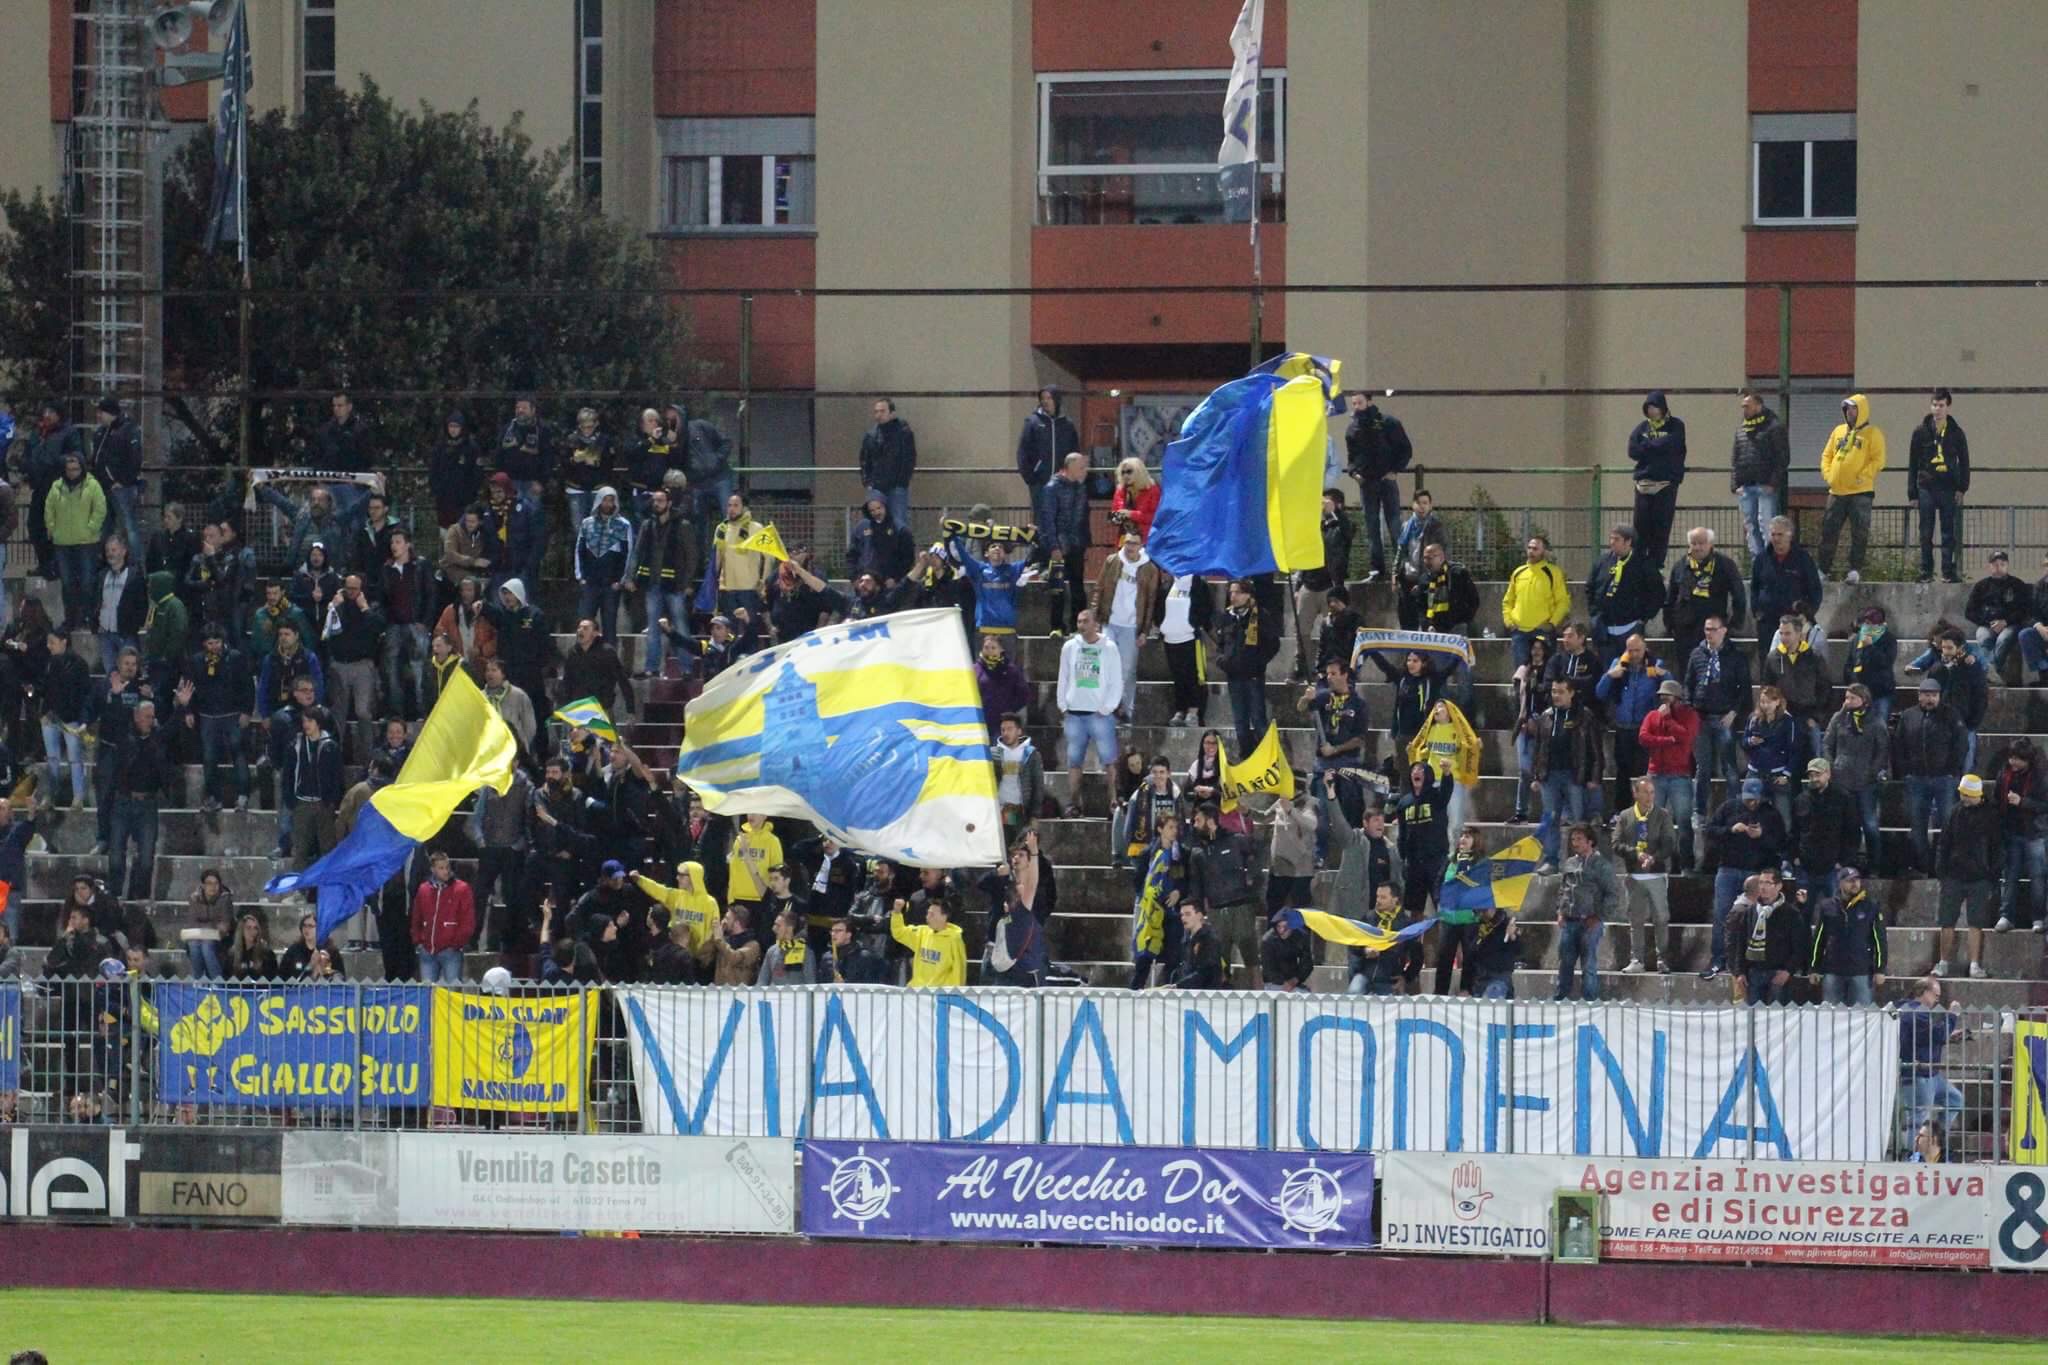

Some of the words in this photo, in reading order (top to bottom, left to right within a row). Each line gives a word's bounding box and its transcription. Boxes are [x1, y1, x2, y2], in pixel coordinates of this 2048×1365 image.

[943, 519, 1036, 542] ODEN
[625, 991, 891, 1141] VIA
[936, 993, 1135, 1147] DA
[1182, 1007, 1794, 1160] MODENA
[0, 1127, 141, 1218] let
[457, 1149, 554, 1185] Vendita
[562, 1151, 662, 1186] Casette
[937, 1154, 999, 1201] Al
[1002, 1155, 1147, 1203] Vecchio
[1160, 1158, 1242, 1206] Doc
[1579, 1163, 1724, 1195] Agenzia
[1734, 1167, 1985, 1201] Investigativa
[172, 1181, 248, 1207] FANO
[950, 1209, 1226, 1235] www.alvecchiodoc.it
[1651, 1201, 1671, 1223] e
[1680, 1197, 1713, 1223] di
[1723, 1197, 1910, 1228] Sicurezza
[1415, 1224, 1547, 1249] INVESTIGATIO
[1598, 1225, 1641, 1238] OME
[1645, 1227, 1694, 1240] FARE
[1696, 1228, 1773, 1242] QUANDO
[1778, 1230, 1818, 1243] NON
[1822, 1231, 1905, 1245] RIUSCITE
[1908, 1233, 1921, 1245] A
